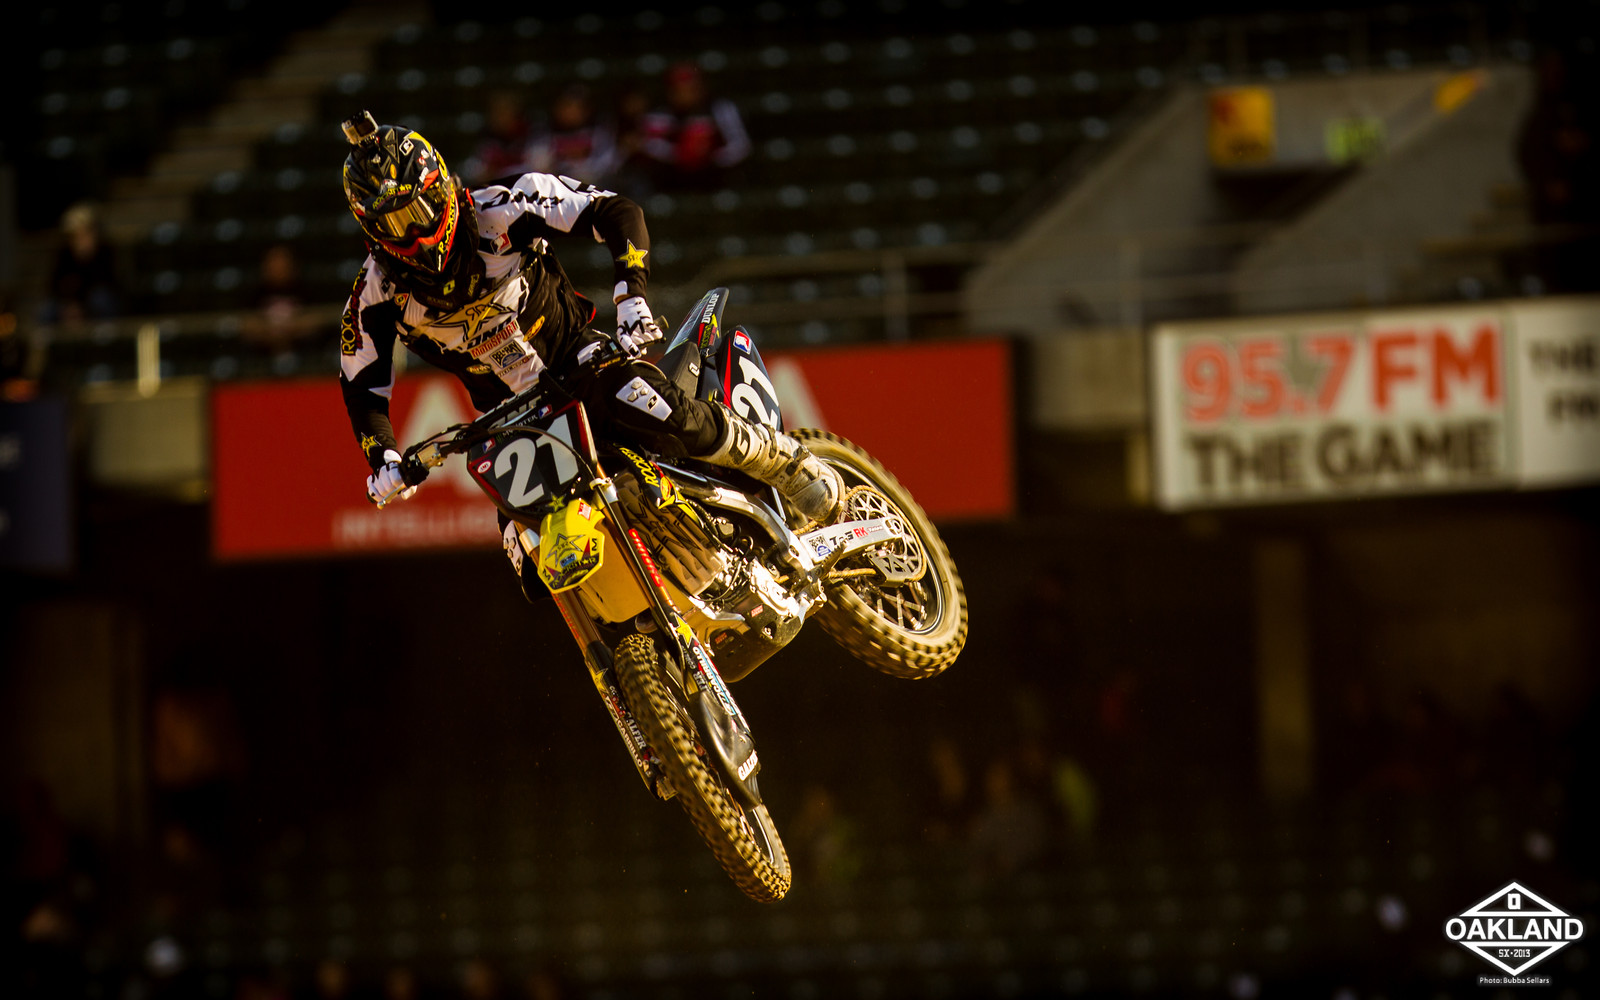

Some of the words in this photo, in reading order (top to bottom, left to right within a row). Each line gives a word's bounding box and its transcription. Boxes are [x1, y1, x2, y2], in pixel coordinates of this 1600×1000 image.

[701, 293, 719, 324] DUNLOP
[1181, 335, 1353, 421] 95.7
[1372, 325, 1499, 410] FM
[494, 413, 579, 508] 21
[1189, 431, 1298, 486] THE
[1315, 418, 1498, 482] GAME
[853, 527, 869, 538] RK
[693, 646, 723, 694] CARRILLO
[617, 719, 643, 767] CARRILLO
